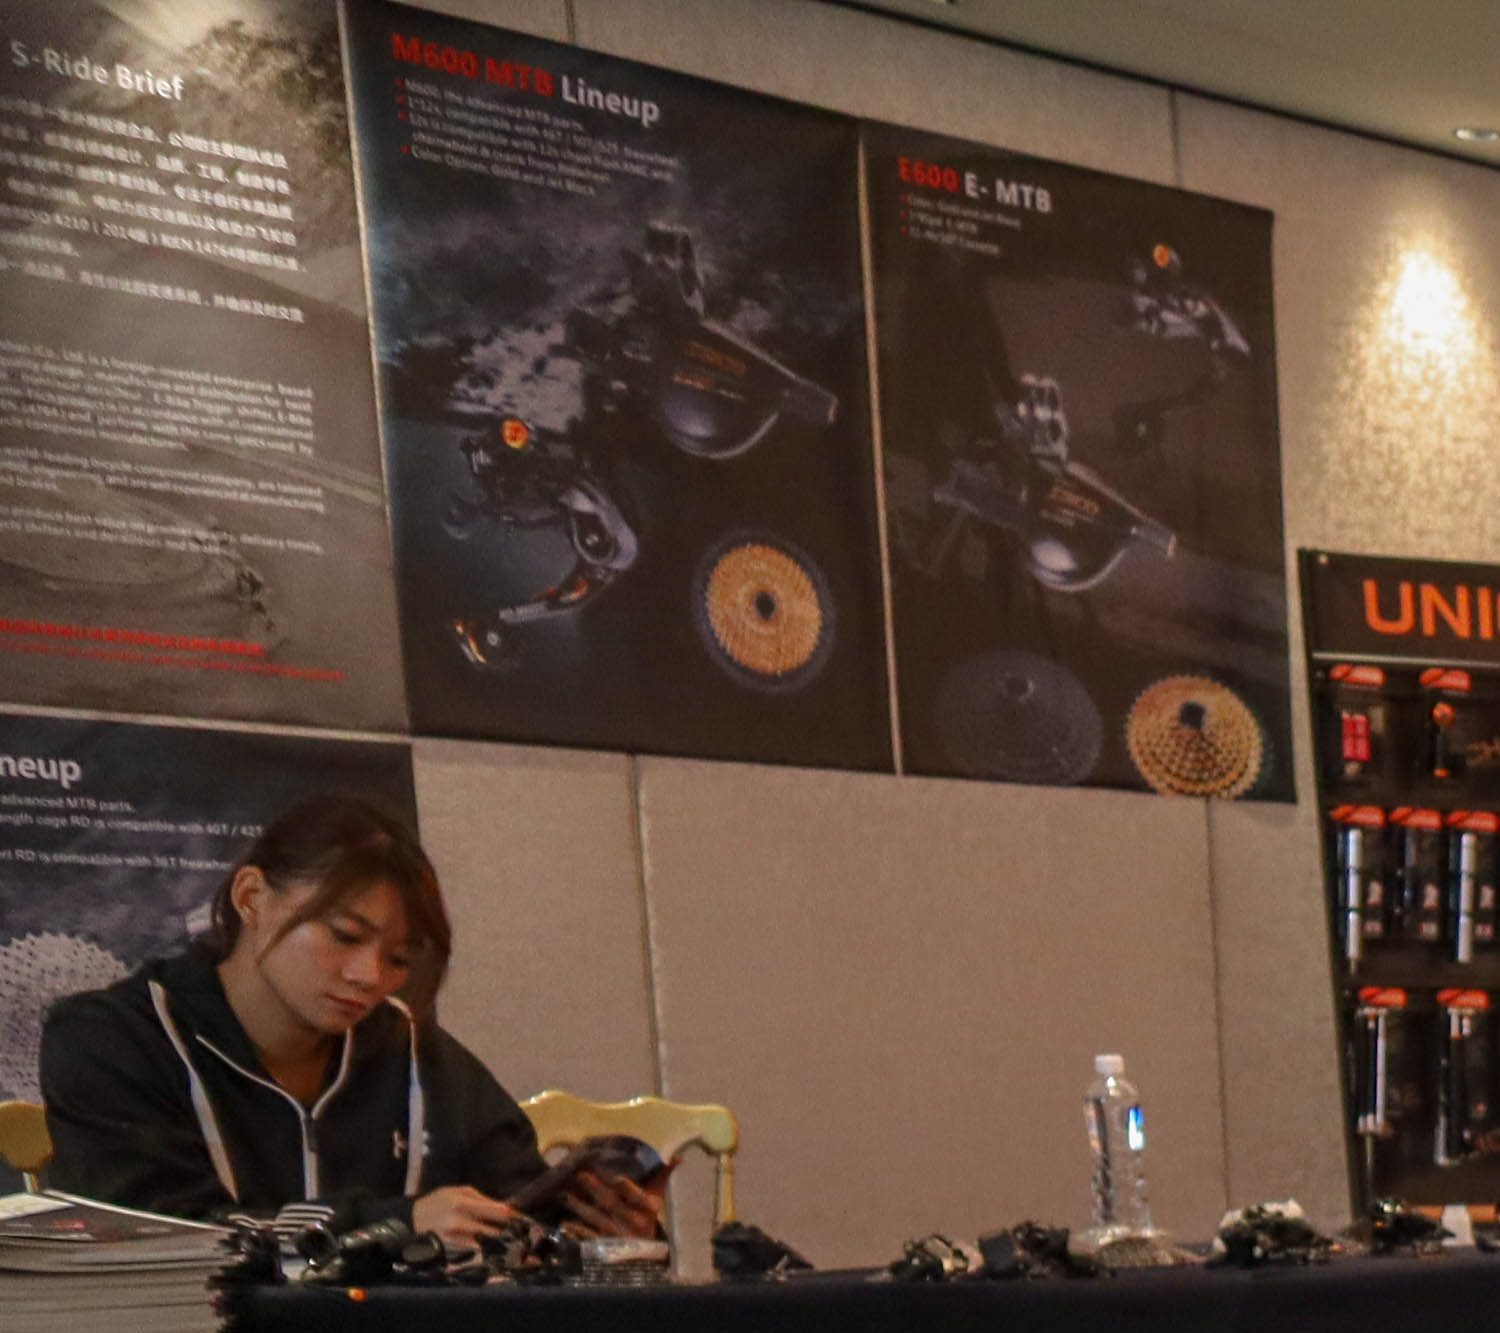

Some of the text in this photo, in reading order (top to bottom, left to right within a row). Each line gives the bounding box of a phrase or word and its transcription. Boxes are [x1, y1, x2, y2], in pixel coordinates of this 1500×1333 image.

[10, 39, 185, 101] S-Ride Brief
[392, 32, 660, 128] M600 MTB Lineup
[898, 155, 960, 193] E600
[995, 178, 1052, 213] MTB
